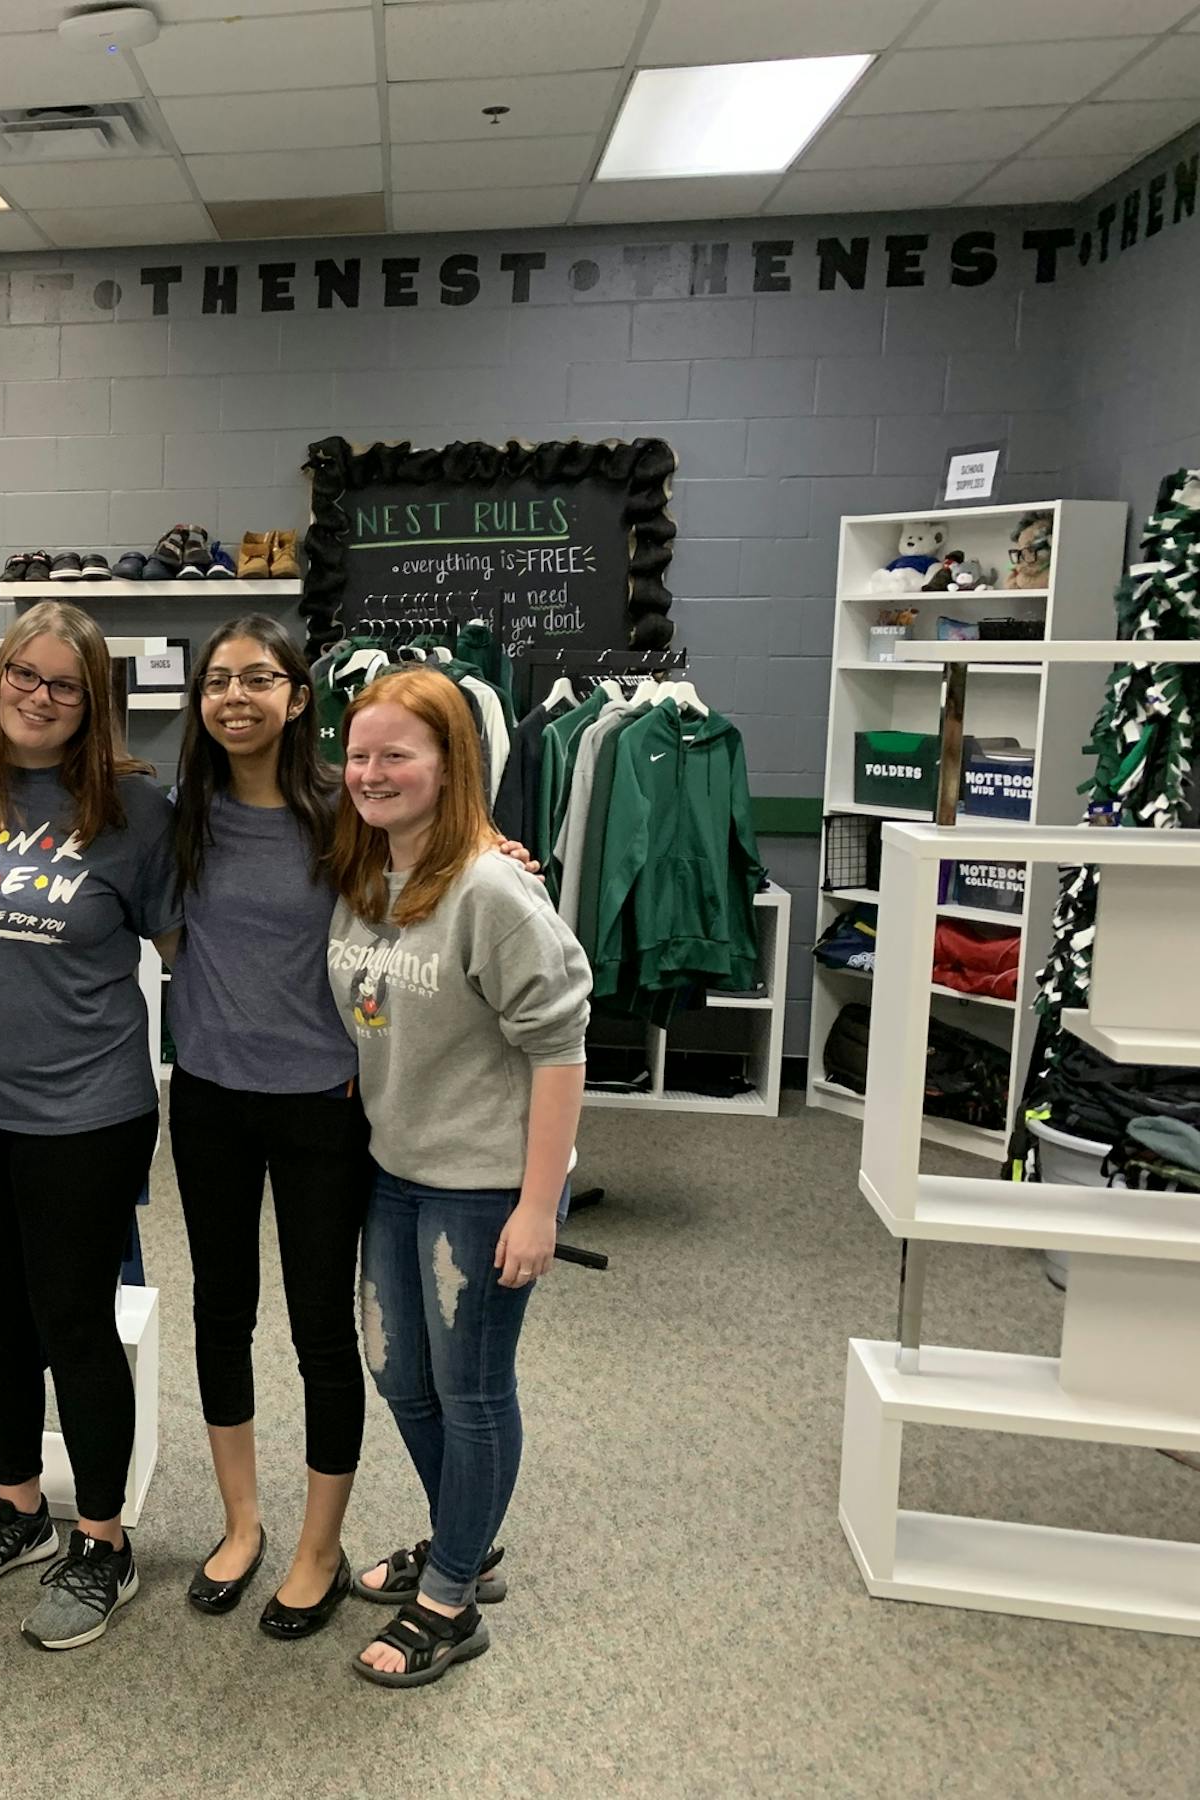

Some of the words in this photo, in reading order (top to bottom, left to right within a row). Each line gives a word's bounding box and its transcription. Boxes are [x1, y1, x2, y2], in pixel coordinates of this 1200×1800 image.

[357, 501, 449, 537] NEST
[402, 550, 495, 584] everything
[501, 549, 515, 571] is
[526, 546, 585, 574] FREE
[511, 616, 536, 640] you
[544, 606, 585, 631] dont
[150, 659, 171, 669] SHOES
[865, 763, 922, 780] FOLDERS
[970, 785, 995, 796] WIDE
[965, 876, 1005, 890] COLLEGE
[8, 911, 38, 927] FOR
[39, 917, 66, 932] YOU
